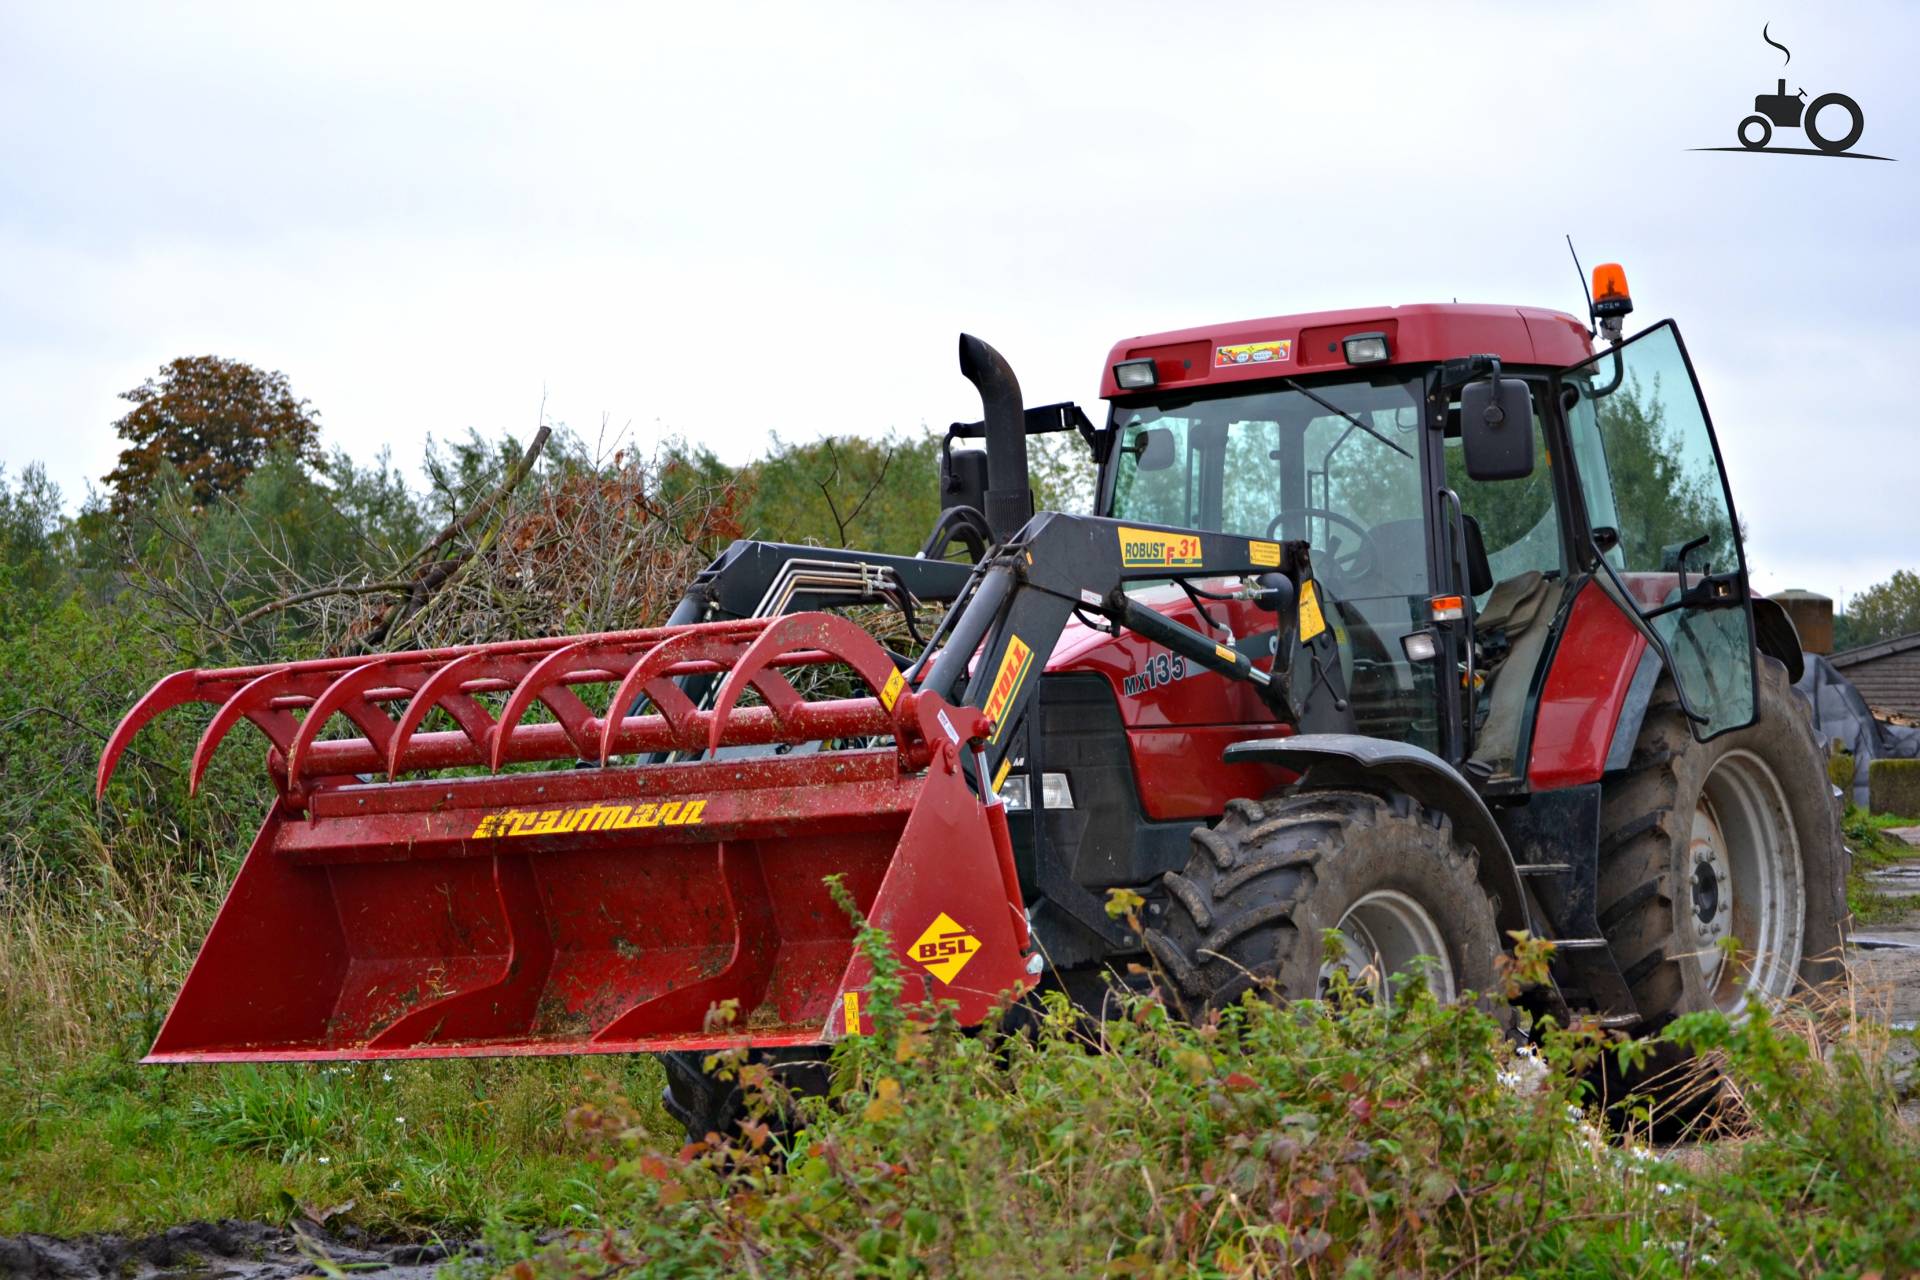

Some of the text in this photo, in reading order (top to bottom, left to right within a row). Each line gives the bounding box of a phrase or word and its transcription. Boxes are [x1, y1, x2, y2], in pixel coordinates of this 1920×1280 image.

[1125, 542, 1165, 559] ROBUST
[1179, 538, 1197, 557] 31
[919, 938, 973, 959] BSL
